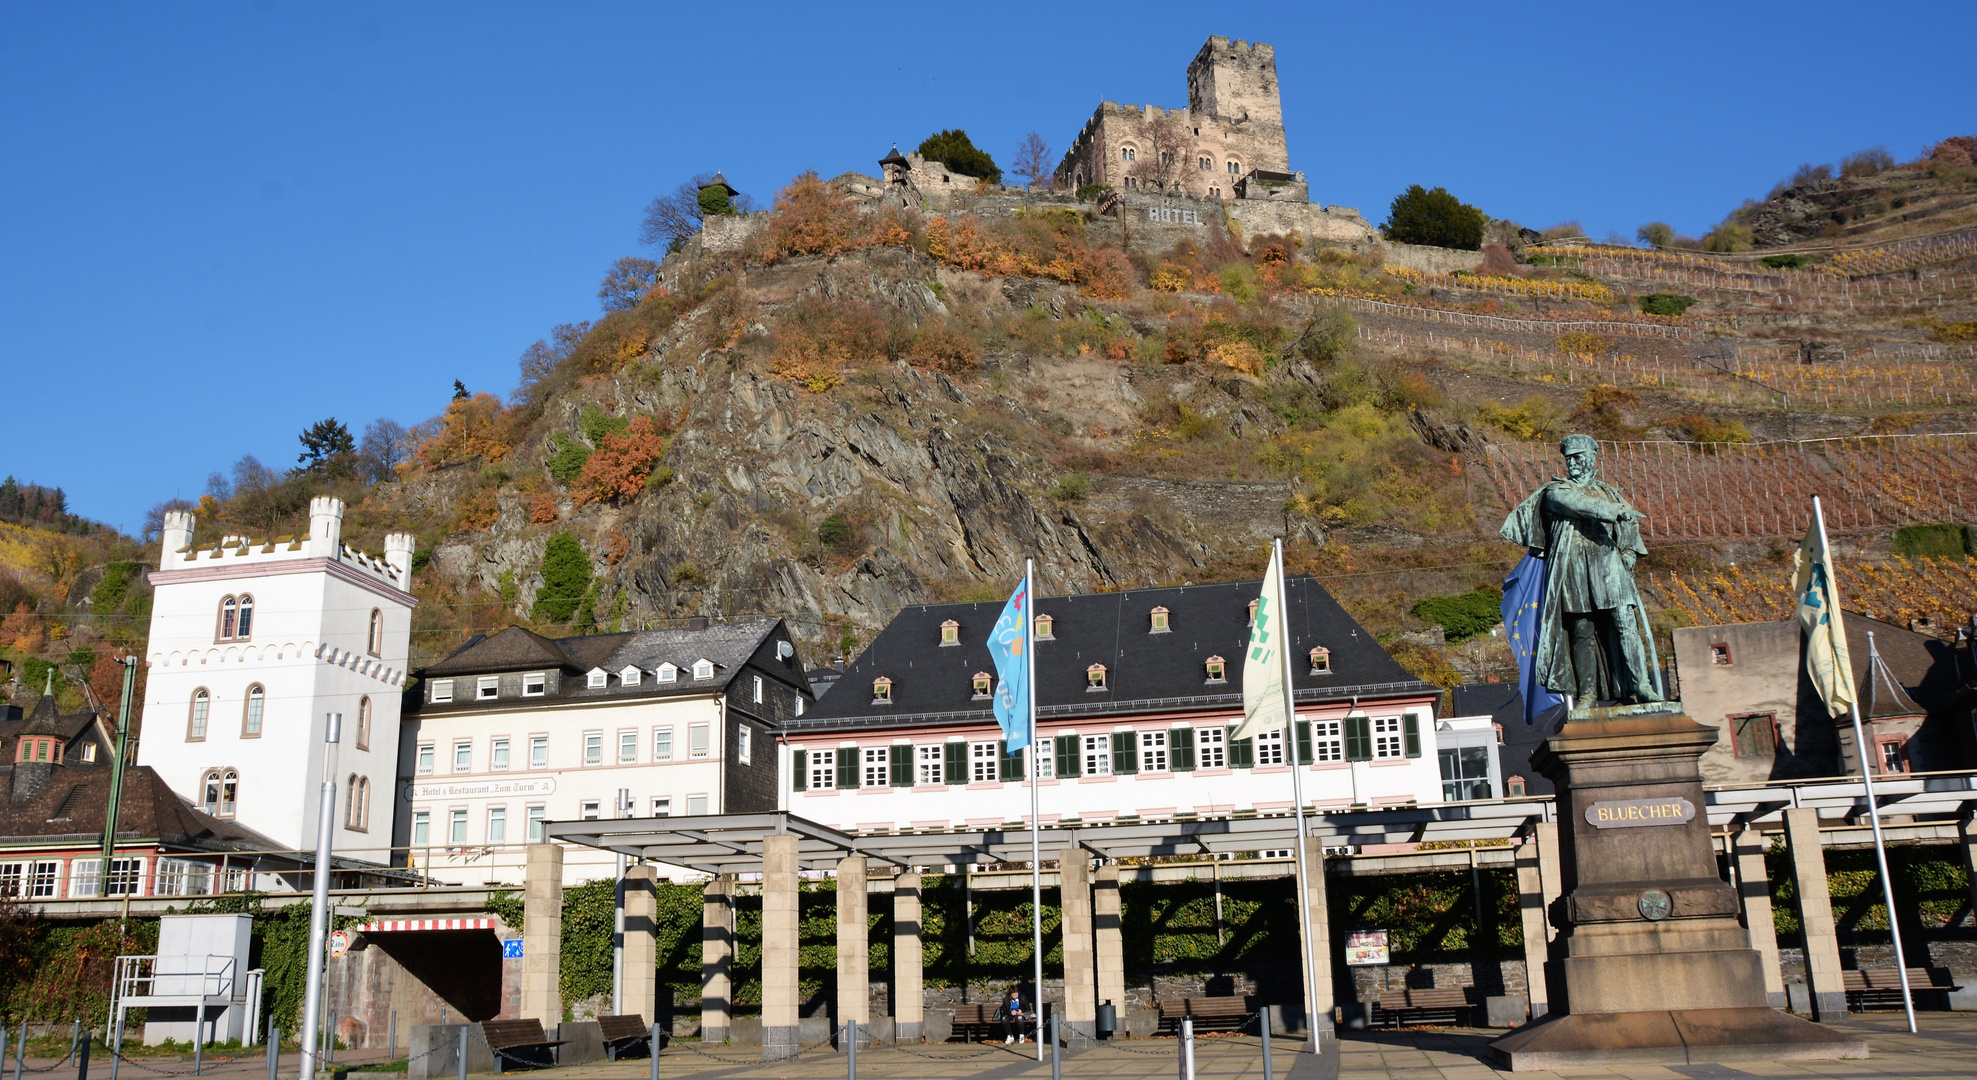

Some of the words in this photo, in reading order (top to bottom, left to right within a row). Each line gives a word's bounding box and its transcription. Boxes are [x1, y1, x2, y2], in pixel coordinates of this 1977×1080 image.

[1149, 206, 1204, 226] HOTEL
[422, 787, 441, 796] Hotel
[448, 785, 489, 795] Restaurant
[1598, 803, 1683, 821] BLUECHER
